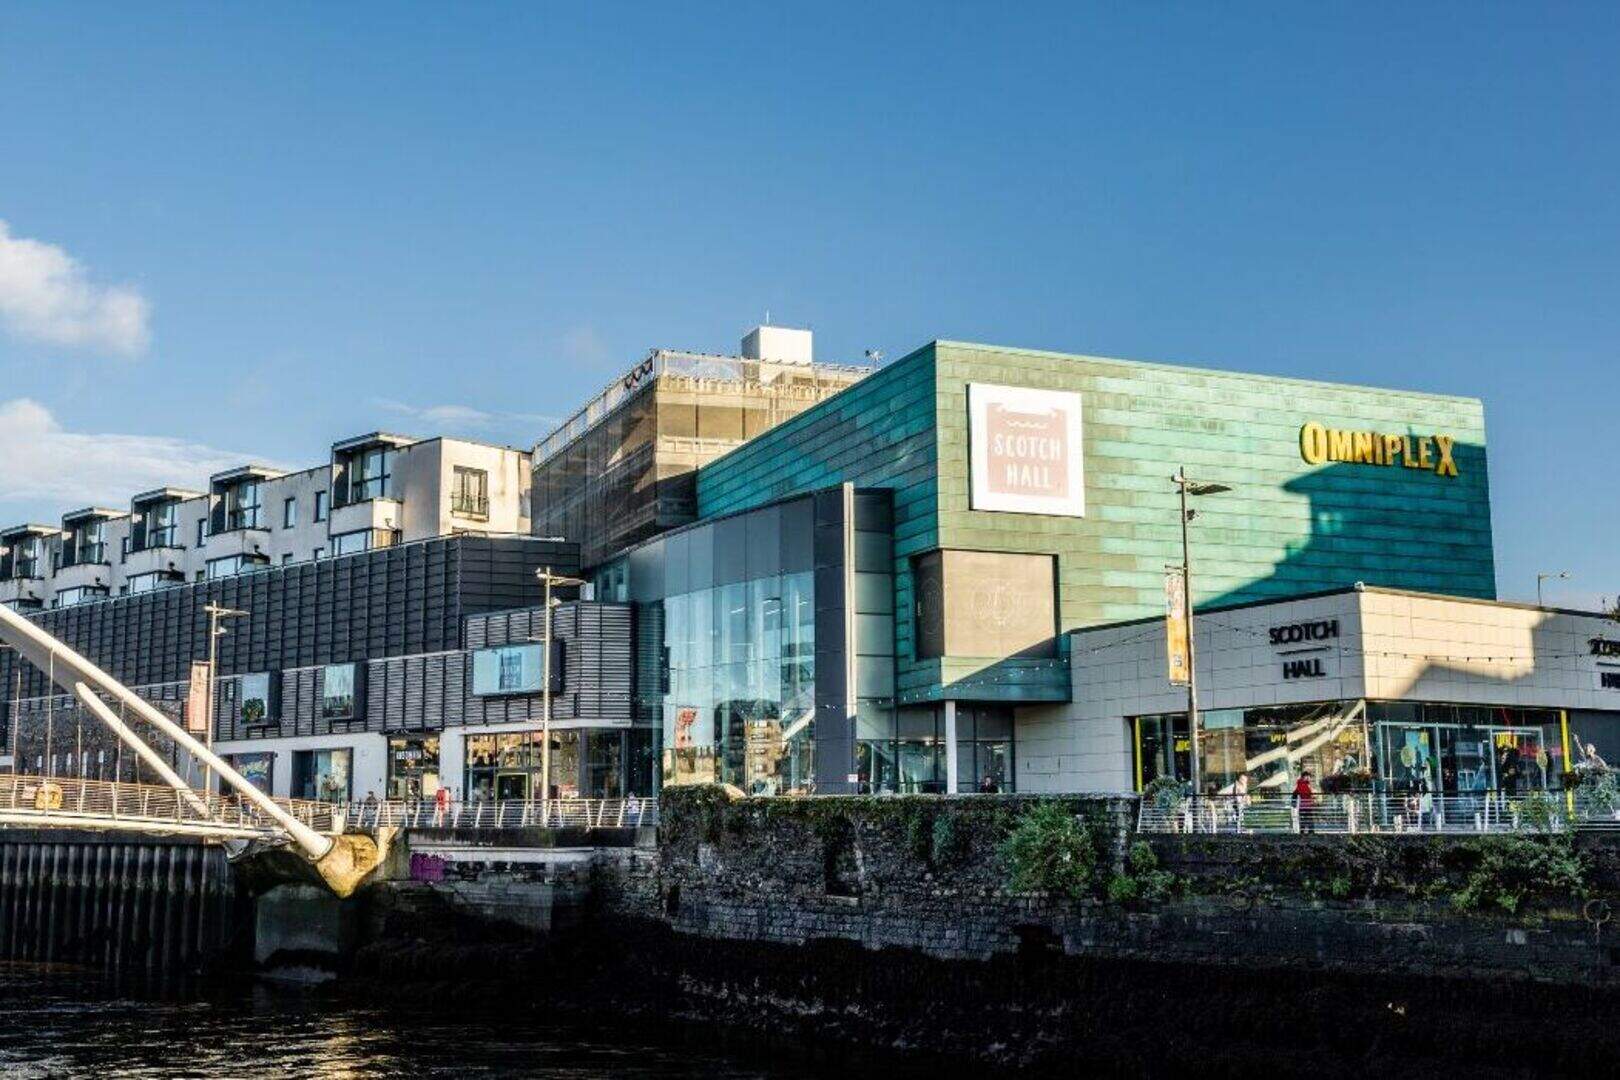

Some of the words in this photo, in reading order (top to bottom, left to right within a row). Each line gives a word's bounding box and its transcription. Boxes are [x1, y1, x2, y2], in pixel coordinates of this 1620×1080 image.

[993, 434, 1061, 460] SCOTCH
[1300, 420, 1458, 477] OMNIPLEX
[1007, 464, 1052, 490] HALL
[1269, 620, 1339, 645] SCOTCH
[1283, 659, 1326, 679] HALL
